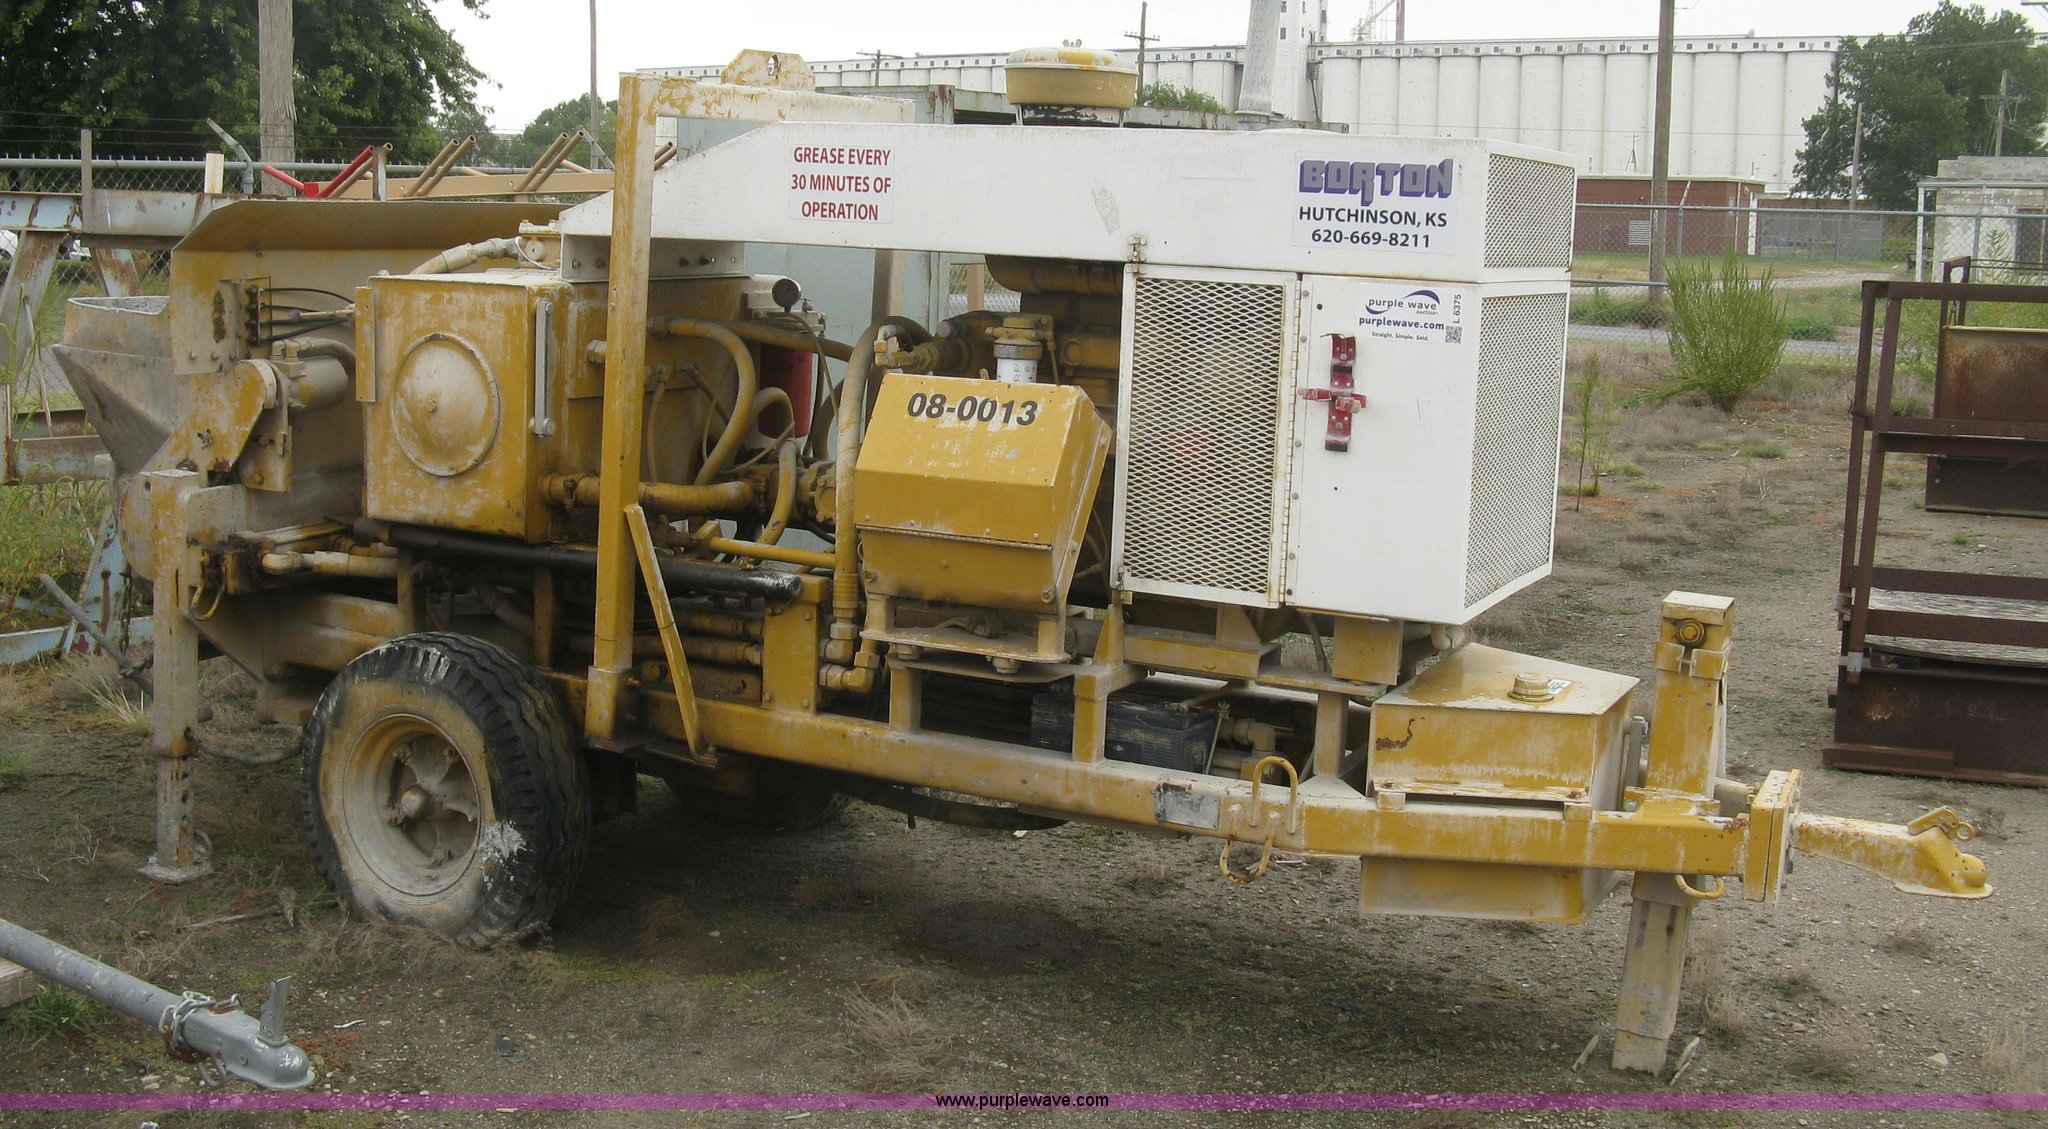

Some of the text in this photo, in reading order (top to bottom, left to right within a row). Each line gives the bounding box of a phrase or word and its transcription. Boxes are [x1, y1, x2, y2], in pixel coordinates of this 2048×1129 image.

[793, 146, 891, 166] GREASE EVERY
[791, 174, 892, 194] 30 MINUTES OF
[1299, 158, 1454, 207] BORTON
[801, 201, 878, 221] OPERATION
[1299, 206, 1447, 228] HUTCHINSON, KS
[1311, 228, 1431, 248] 620-669-8211
[1368, 298, 1437, 311] purple wave
[1453, 294, 1461, 316] 6375
[1359, 317, 1444, 330] purplewave.com
[907, 392, 1038, 426] 08-0013
